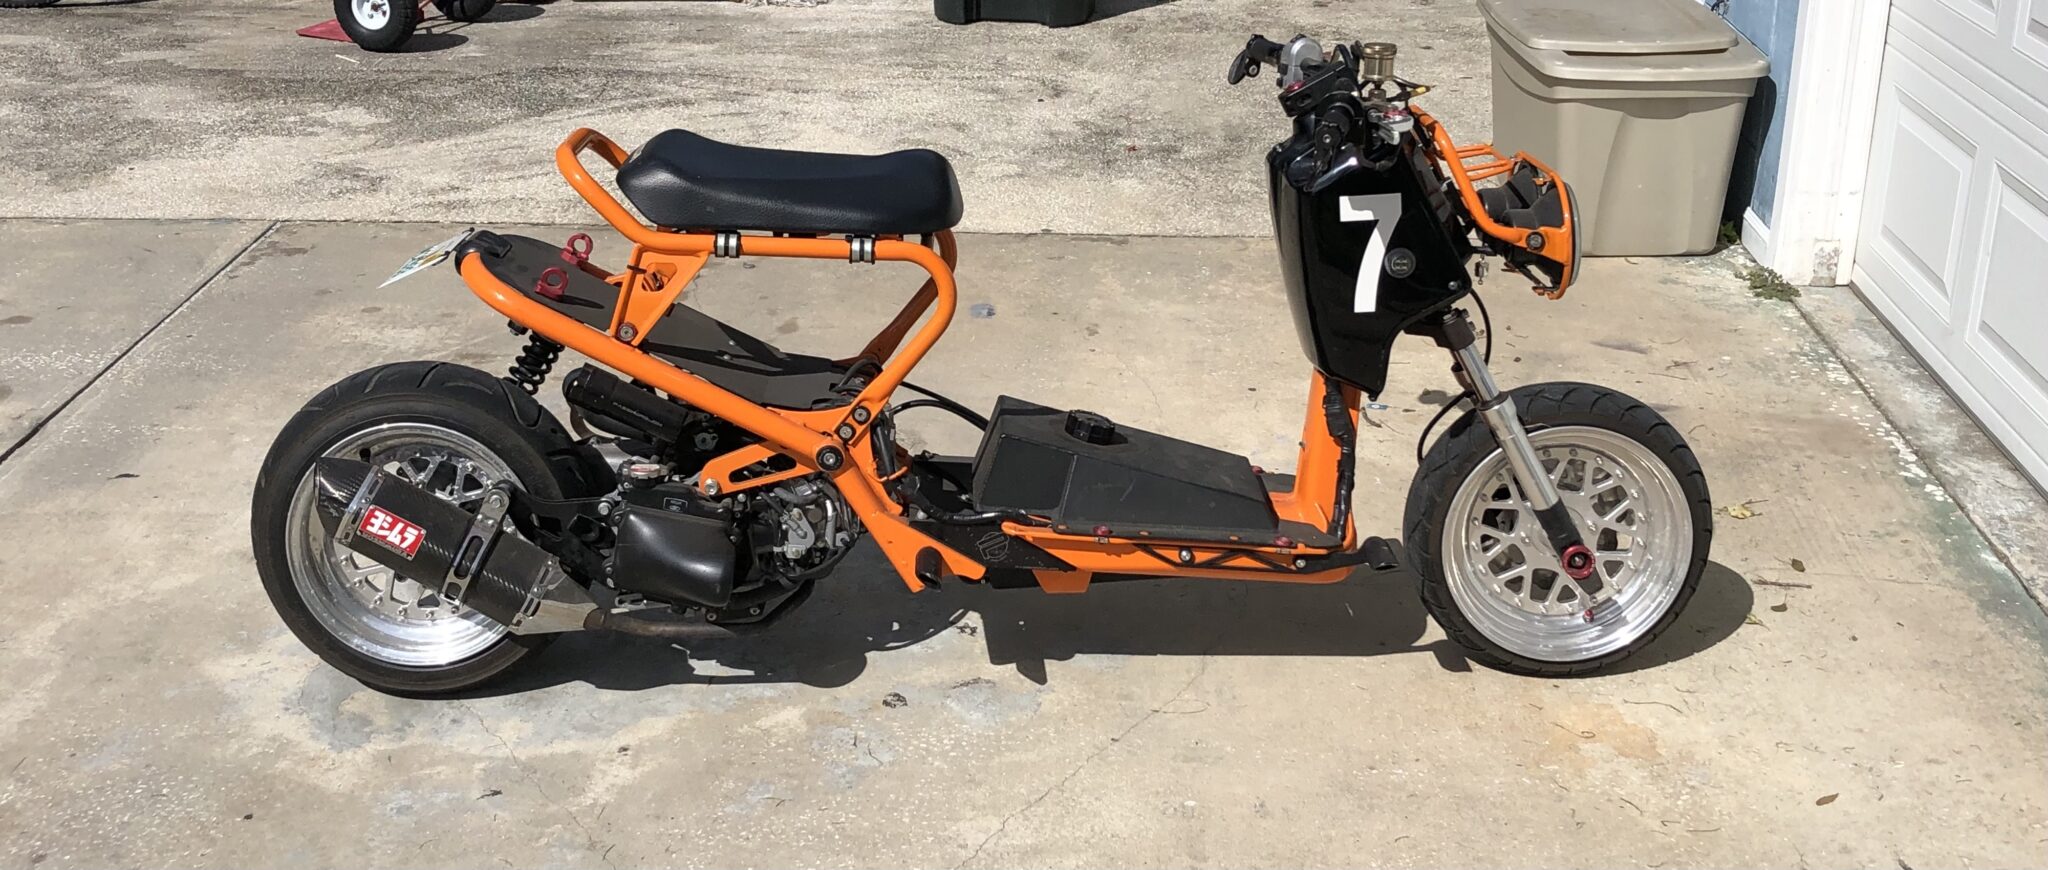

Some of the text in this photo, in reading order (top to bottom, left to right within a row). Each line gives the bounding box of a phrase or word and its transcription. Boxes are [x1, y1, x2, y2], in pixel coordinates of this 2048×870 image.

[1339, 193, 1402, 313] 7
[366, 510, 419, 549] ヨシムラ
